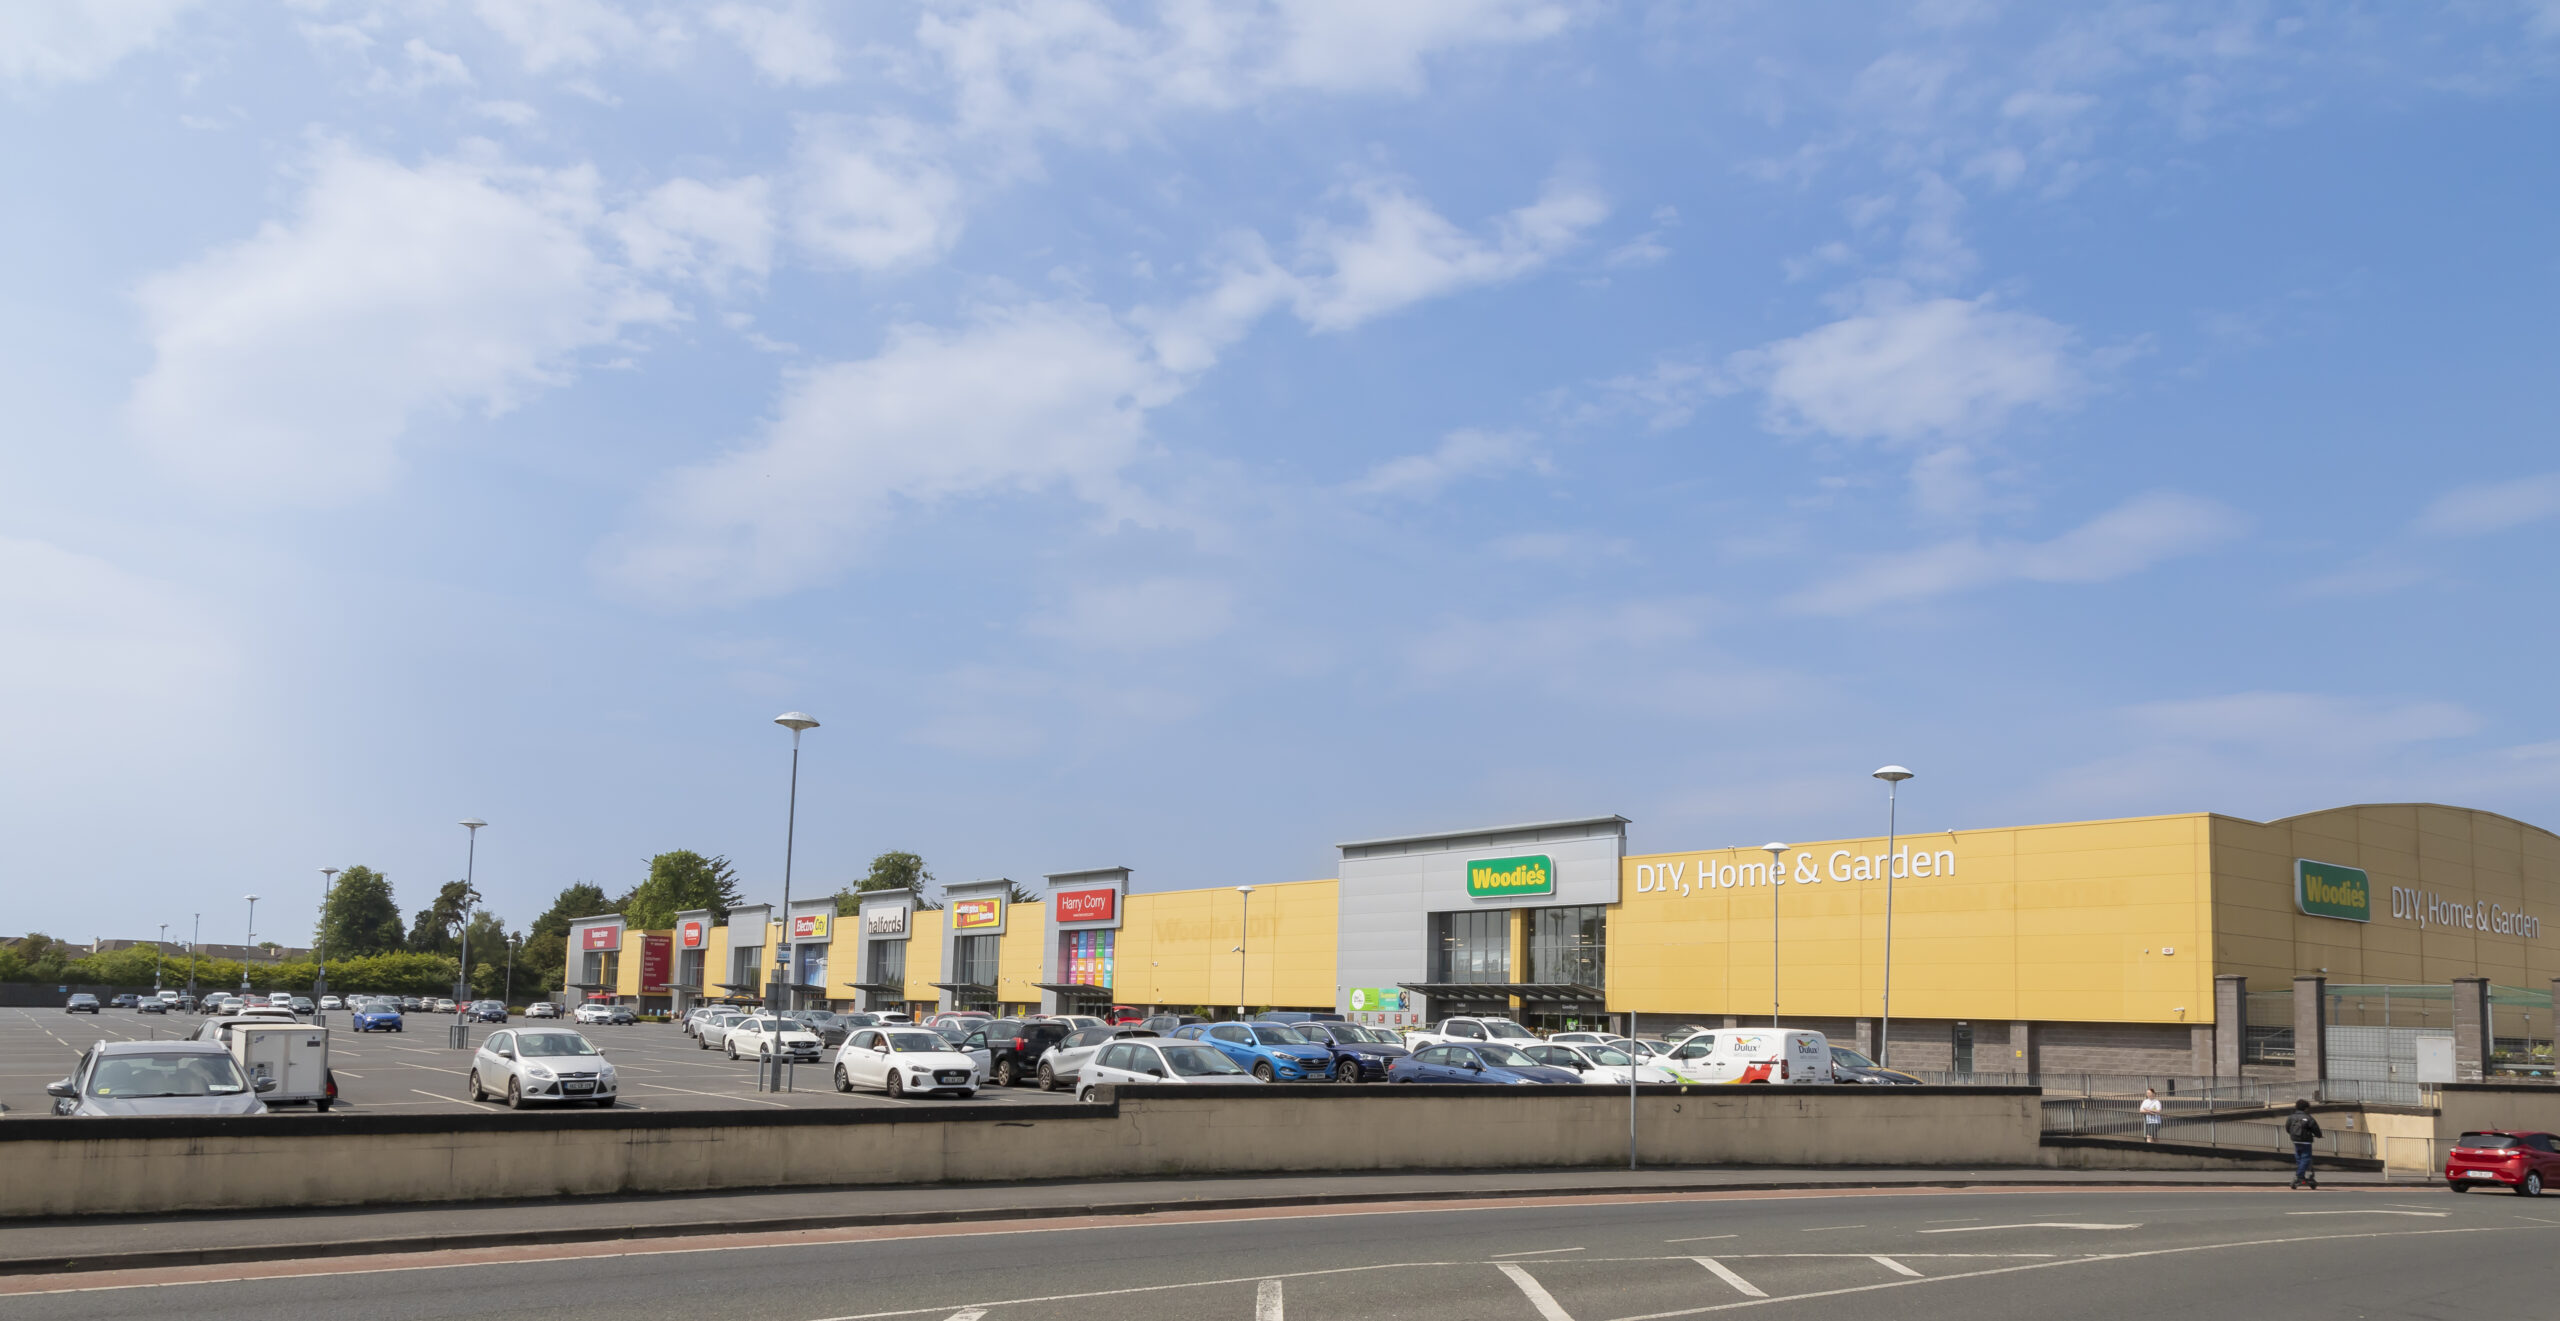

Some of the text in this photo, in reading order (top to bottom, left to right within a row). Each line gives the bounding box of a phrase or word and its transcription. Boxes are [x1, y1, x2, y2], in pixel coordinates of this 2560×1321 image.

[1472, 863, 1545, 889] Woodie's
[1637, 845, 1956, 897] DIY, Home & Garden
[2305, 874, 2366, 908] Woodie's
[1062, 894, 1106, 912] Harry Corry
[2392, 886, 2540, 938] DIY, Home & Garden
[796, 919, 814, 932] Electro
[868, 915, 902, 934] halfords
[1734, 1043, 1757, 1052] Dulux
[1798, 1045, 1818, 1054] Dulux
